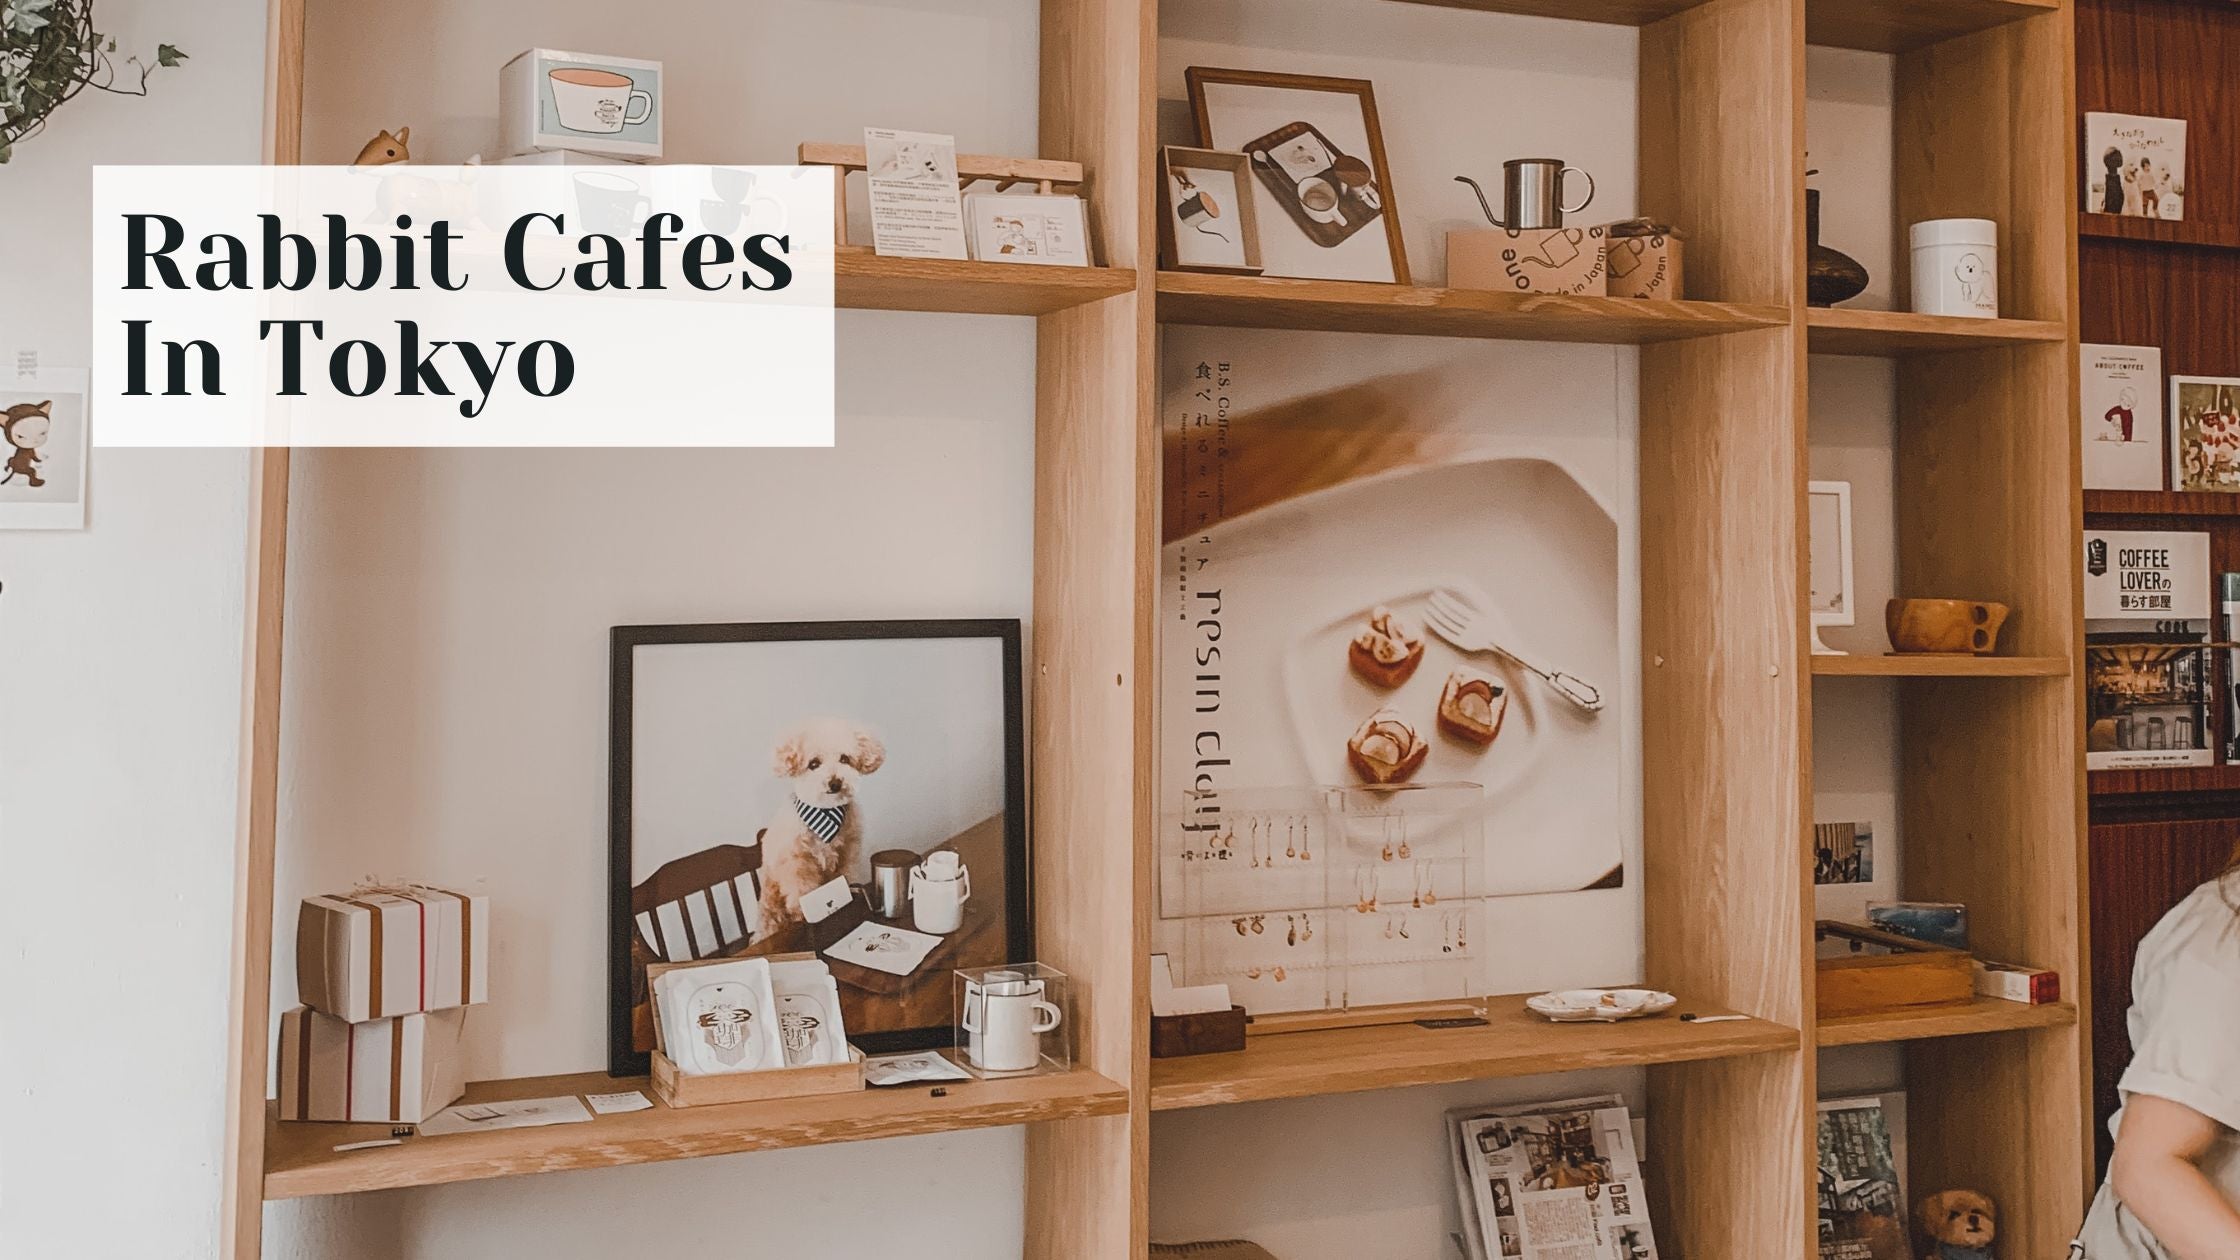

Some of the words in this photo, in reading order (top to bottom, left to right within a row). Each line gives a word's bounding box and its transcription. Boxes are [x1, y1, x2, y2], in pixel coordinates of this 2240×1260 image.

[1502, 248, 1530, 290] one
[1571, 282, 1585, 294] in
[1584, 247, 1606, 284] Japan
[1646, 256, 1666, 292] Japan
[1218, 362, 1231, 391] B.S.
[1218, 397, 1231, 445] Coffee
[2119, 548, 2169, 568] COFFEE
[2120, 571, 2172, 590] LOVERの
[2120, 594, 2172, 609] 暮らす部屋
[1195, 588, 1222, 713] resin
[1181, 731, 1231, 833] clay
